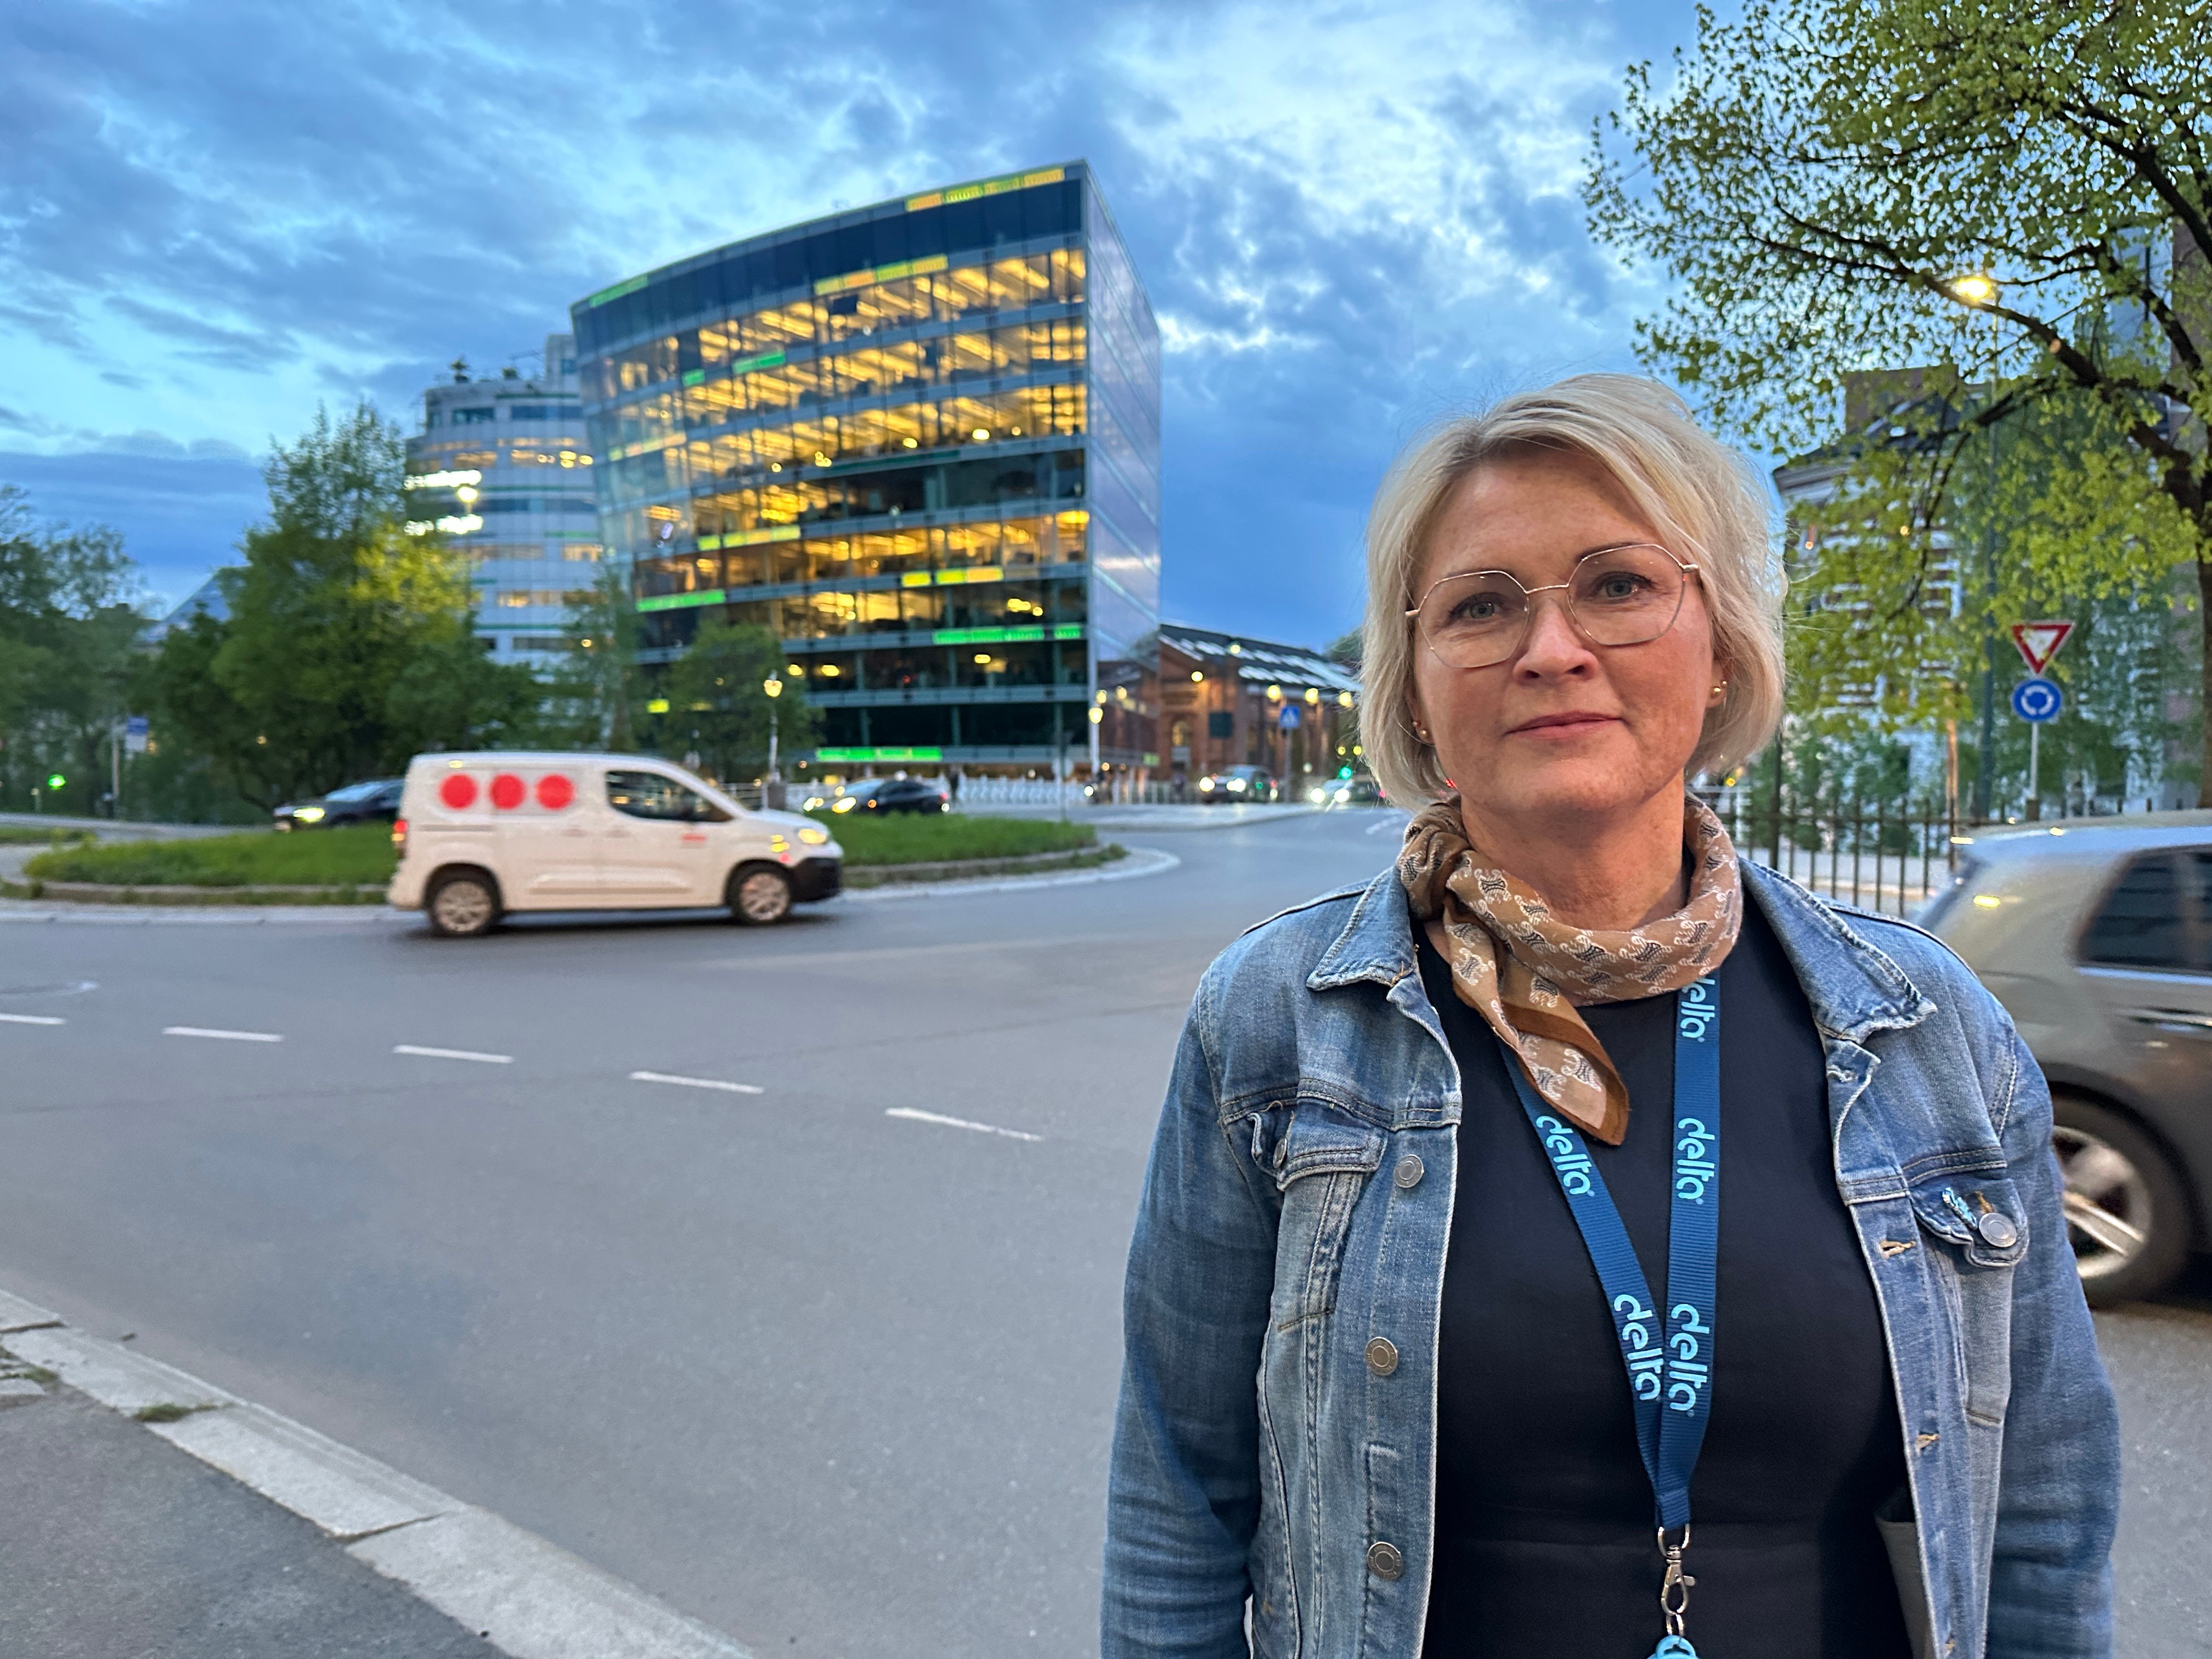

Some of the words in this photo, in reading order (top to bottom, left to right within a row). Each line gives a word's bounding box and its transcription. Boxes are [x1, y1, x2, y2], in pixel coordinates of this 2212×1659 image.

[1536, 1116, 1592, 1194] delta
[1676, 1118, 1715, 1199] delta
[1614, 1294, 1663, 1400] delta
[1668, 1304, 1709, 1410] delta
